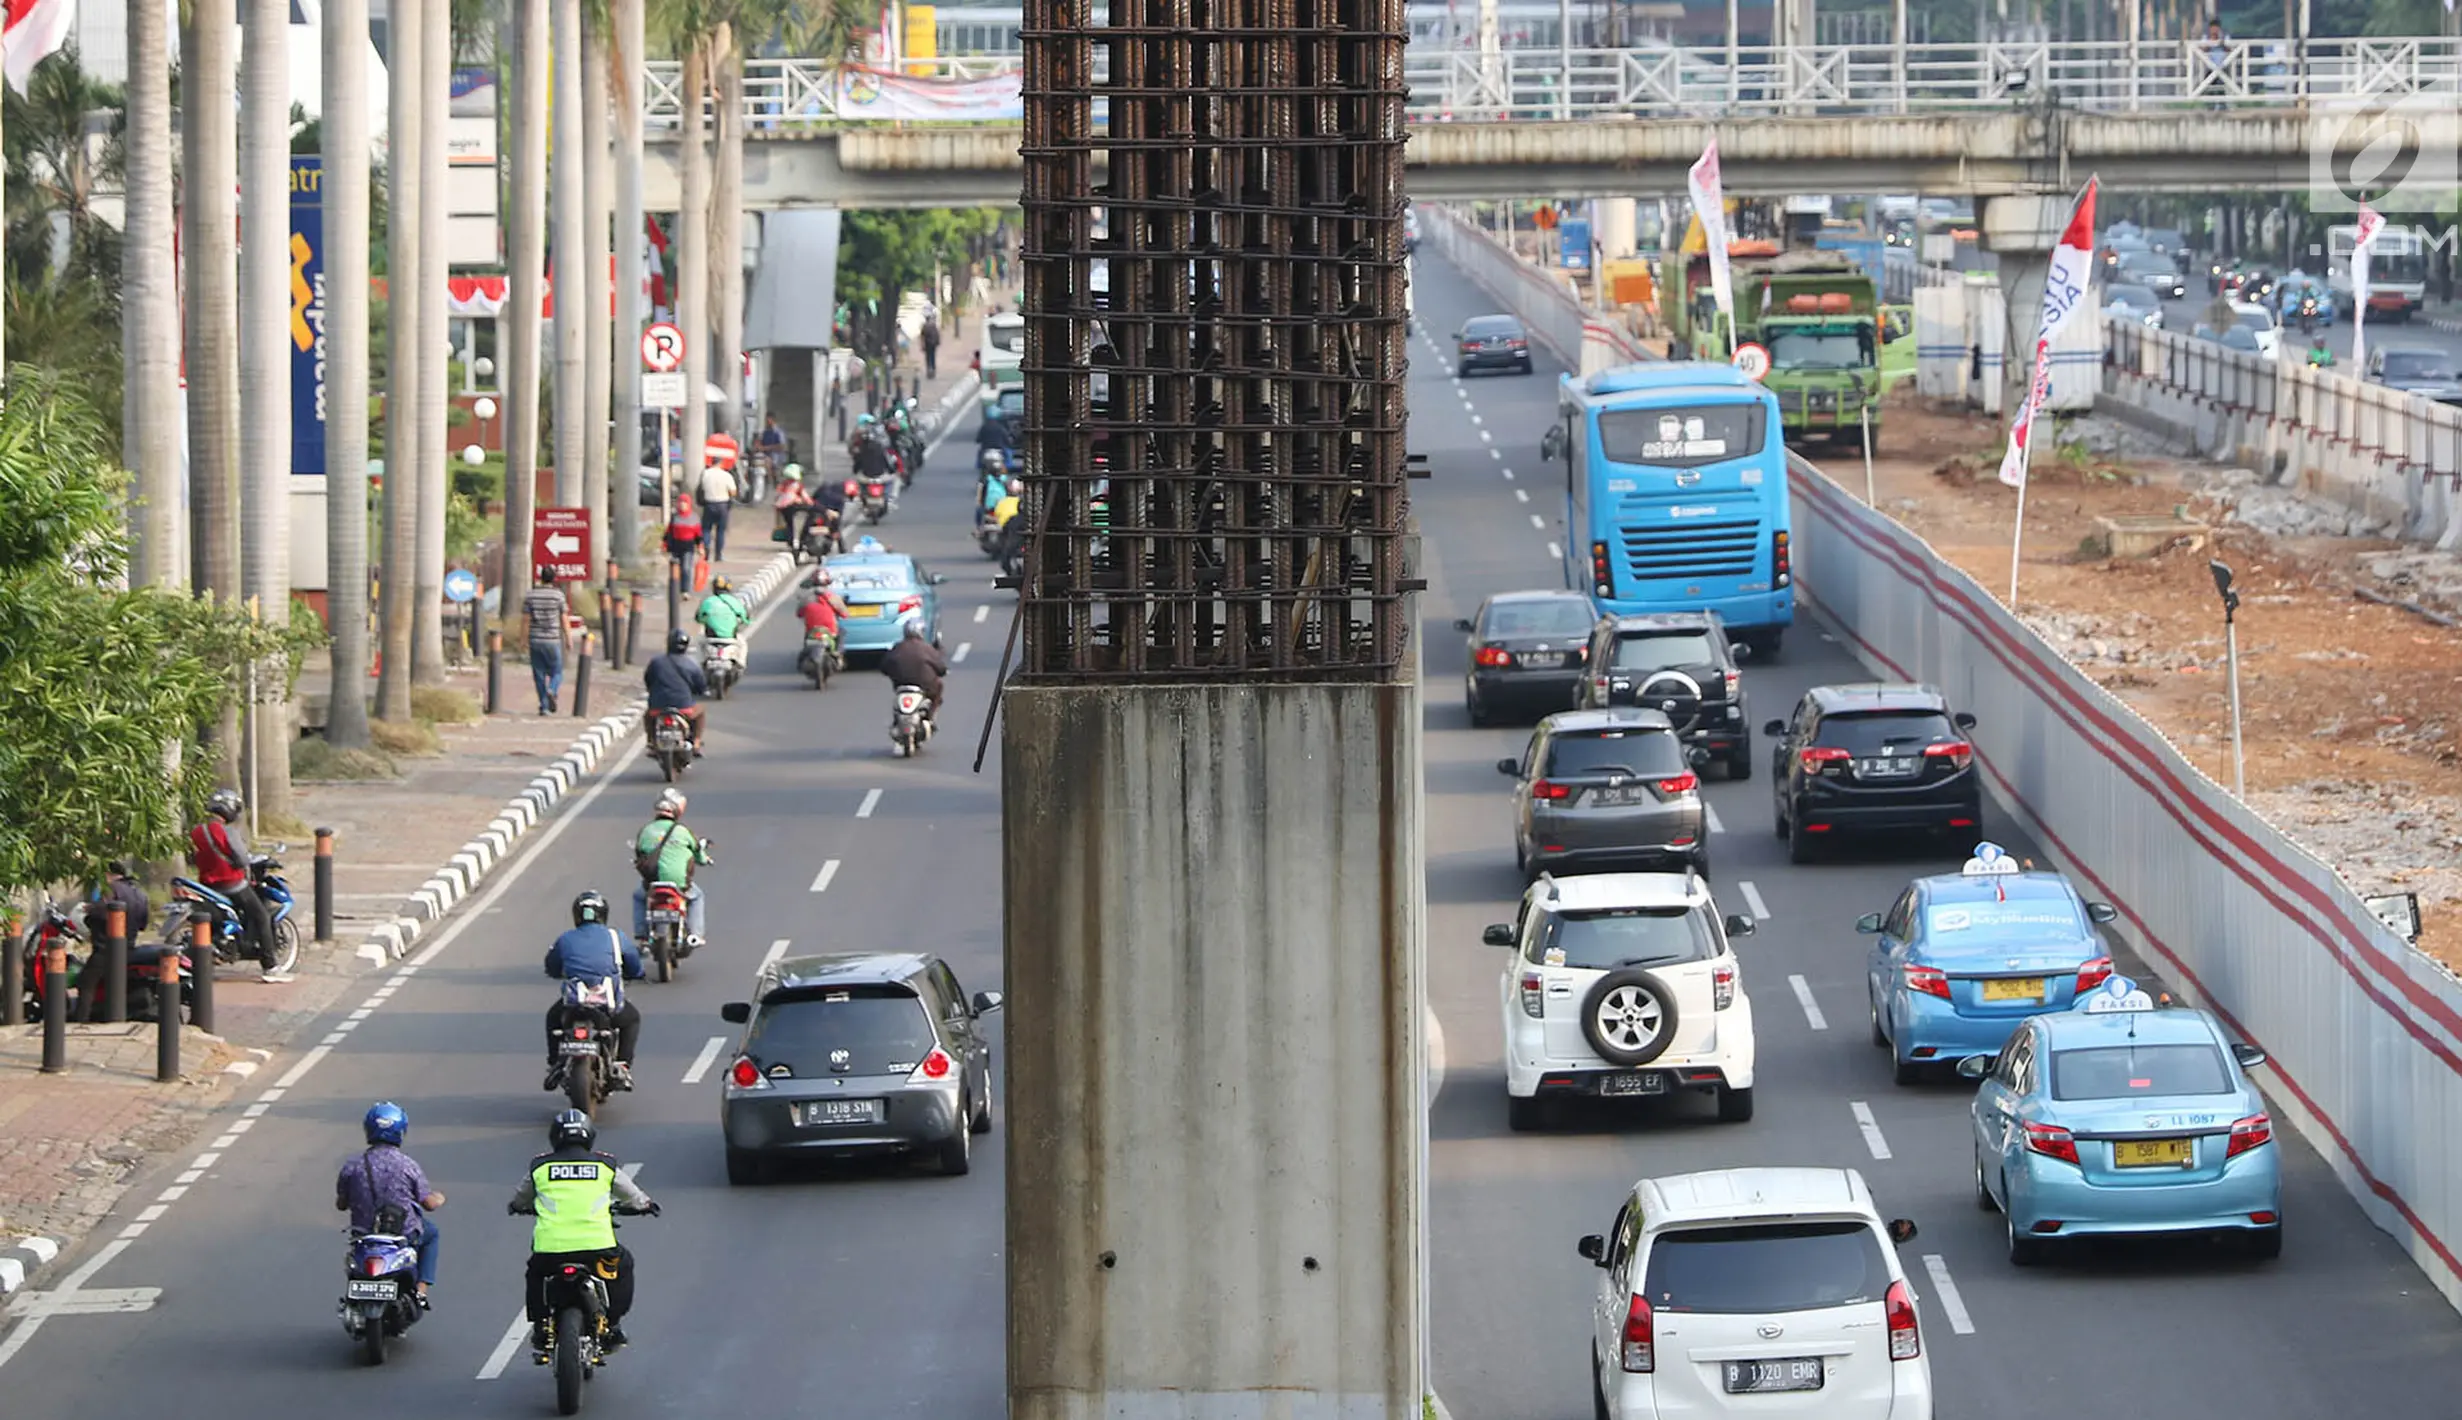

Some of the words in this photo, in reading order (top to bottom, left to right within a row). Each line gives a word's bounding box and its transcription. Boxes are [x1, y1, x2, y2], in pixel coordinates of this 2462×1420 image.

[2101, 1000, 2144, 1009] TAKSI
[2189, 1114, 2215, 1125] 1087
[551, 1166, 597, 1179] POLISI
[1730, 1365, 1739, 1381] B
[1750, 1363, 1782, 1381] 1120
[1792, 1361, 1818, 1379] EMR
